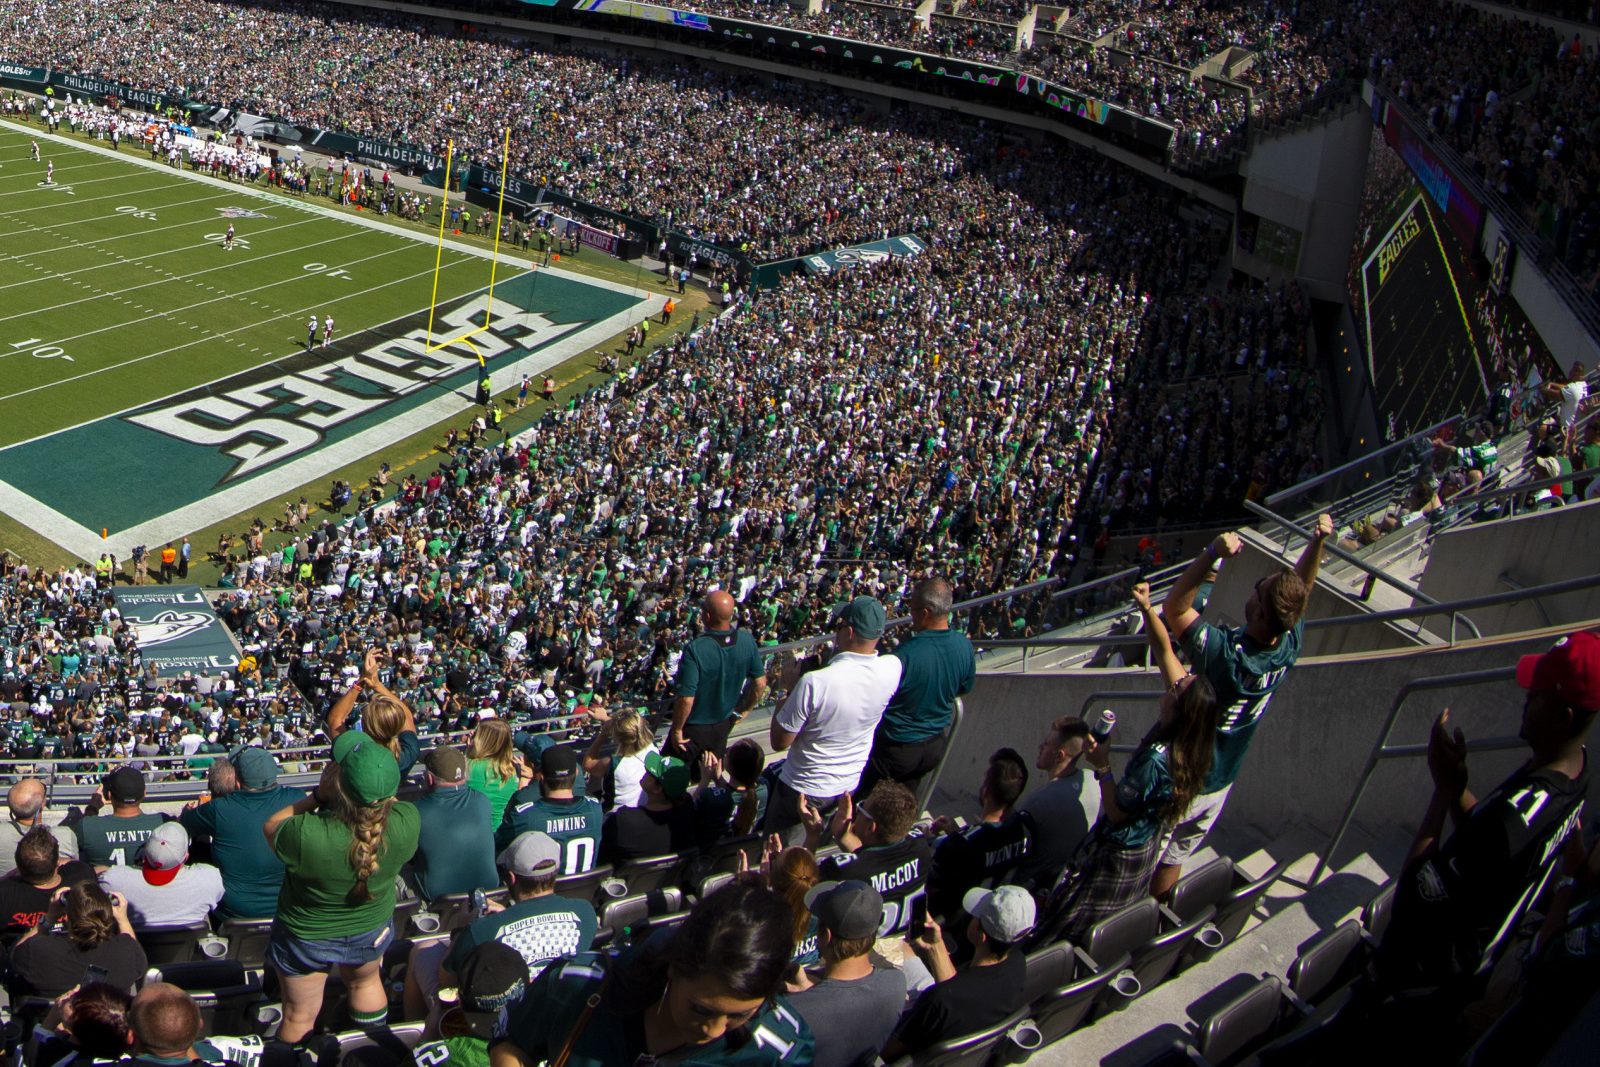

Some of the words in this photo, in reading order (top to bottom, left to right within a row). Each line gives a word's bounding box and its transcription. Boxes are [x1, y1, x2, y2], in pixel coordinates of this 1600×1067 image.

[64, 74, 124, 100] PHILADELPHIA
[127, 89, 163, 107] EAGLES
[357, 140, 445, 170] PHILADELPHIA
[482, 169, 522, 195] EAGLES
[580, 226, 613, 250] KICKOFF
[691, 244, 731, 264] EAGLES
[1378, 212, 1421, 285] EAGLES
[8, 337, 64, 359] 10
[122, 293, 590, 484] EAGLES
[122, 597, 179, 605] Lincoln
[1506, 784, 1552, 829] 11
[547, 816, 587, 834] DAWKINS
[870, 858, 920, 894] McCOY
[509, 917, 535, 932] SUPER
[536, 914, 558, 925] BOWL
[558, 913, 570, 922] LII
[753, 1003, 800, 1062] 11
